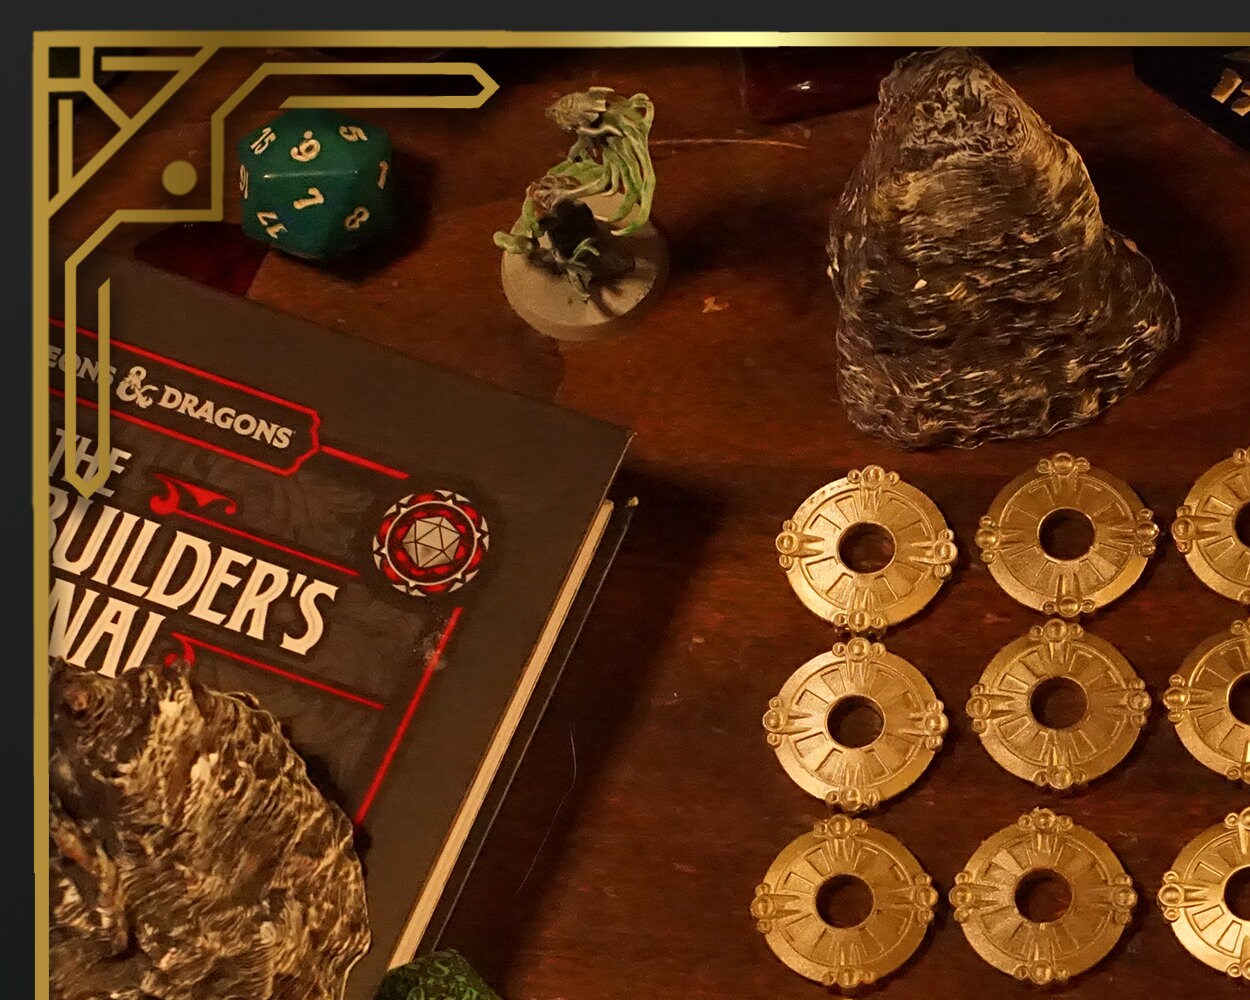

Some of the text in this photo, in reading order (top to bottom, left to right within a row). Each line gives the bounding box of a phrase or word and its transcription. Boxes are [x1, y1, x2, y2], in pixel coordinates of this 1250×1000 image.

[339, 126, 368, 142] 5
[343, 206, 370, 231] 8
[116, 365, 160, 409] &
[157, 385, 293, 449] DRAGONS
[49, 427, 132, 498] THE
